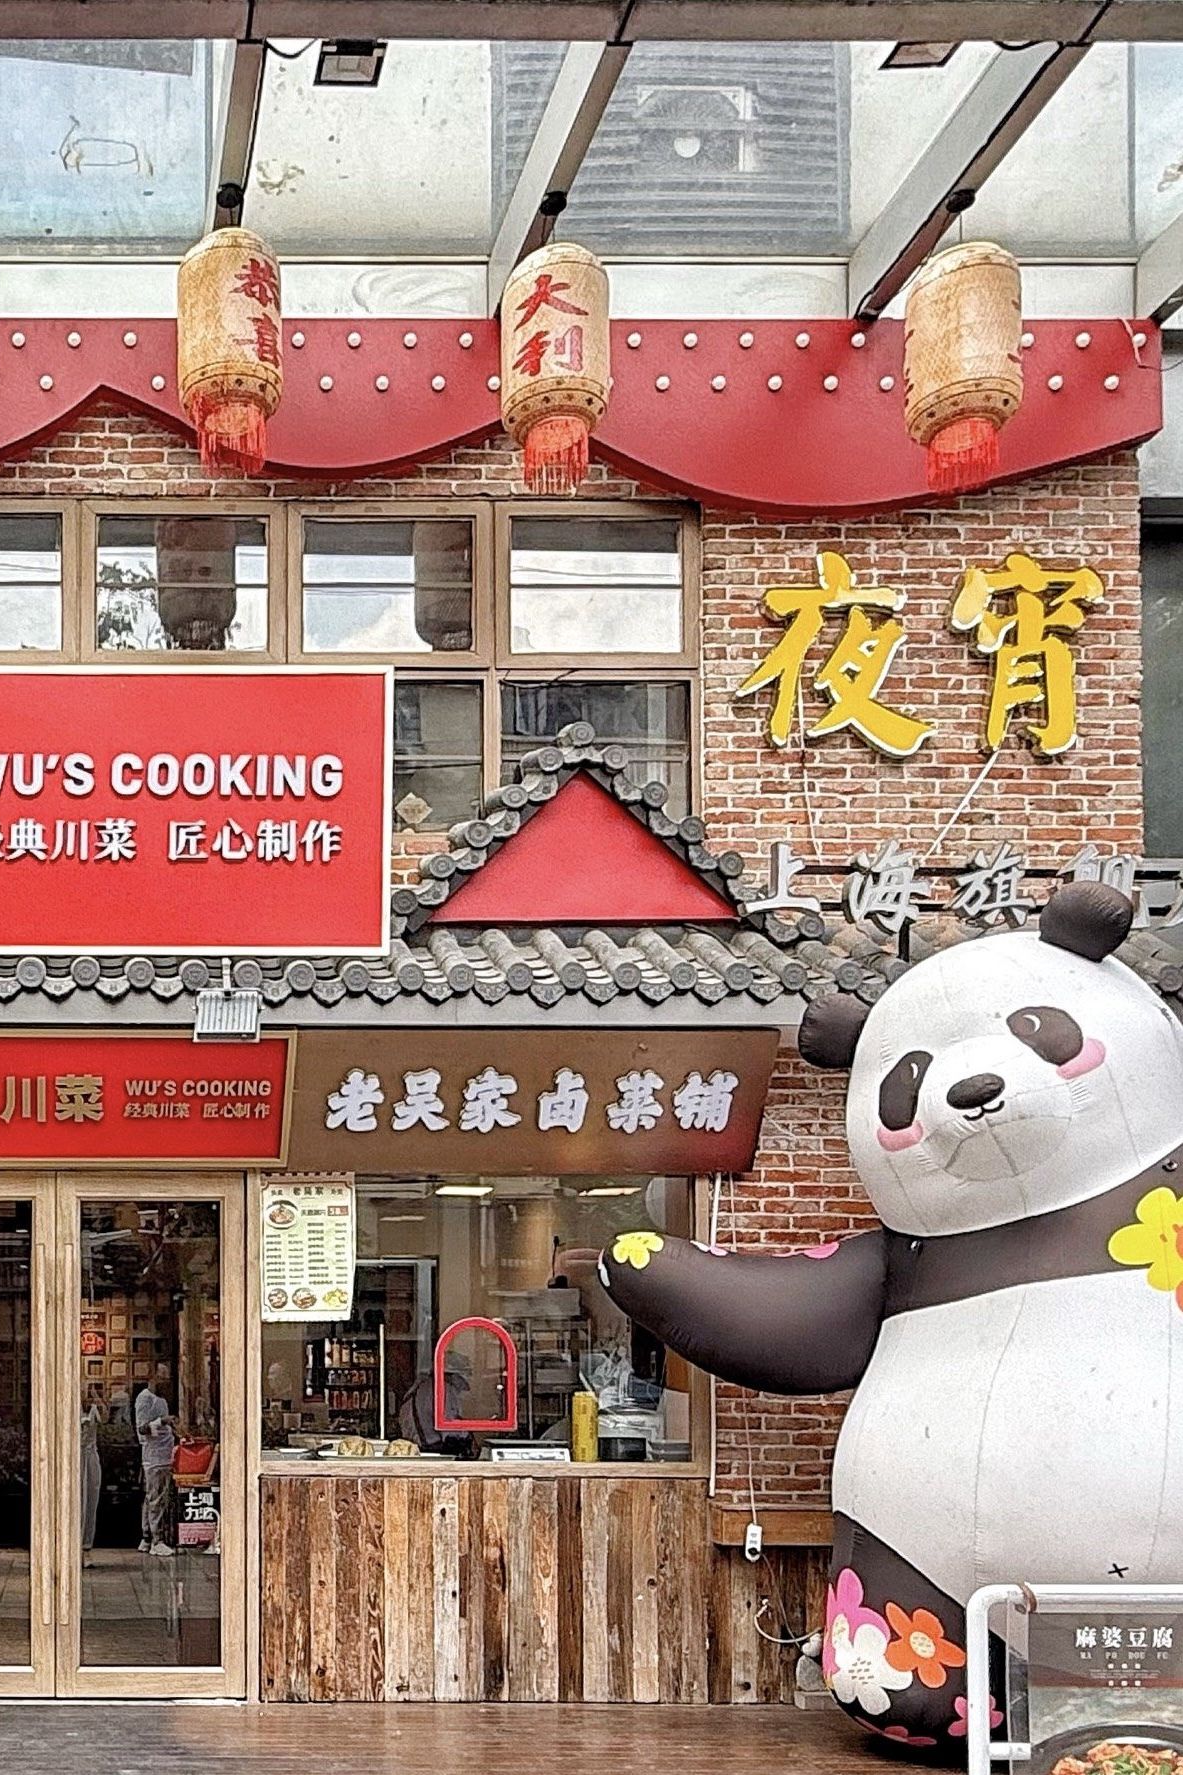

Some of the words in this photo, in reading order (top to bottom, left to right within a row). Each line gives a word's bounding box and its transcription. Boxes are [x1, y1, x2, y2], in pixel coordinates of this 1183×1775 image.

[512, 274, 590, 377] 大利
[735, 551, 1105, 756] 夜宵
[111, 753, 344, 797] COOKING
[167, 817, 343, 862] 匠心制作
[125, 1079, 177, 1097] WU'S
[182, 1079, 272, 1097] COOKING
[123, 1102, 191, 1119] 经典川菜
[202, 1102, 271, 1119] 匠心制作
[1075, 1626, 1174, 1648] 麻婆豆腐
